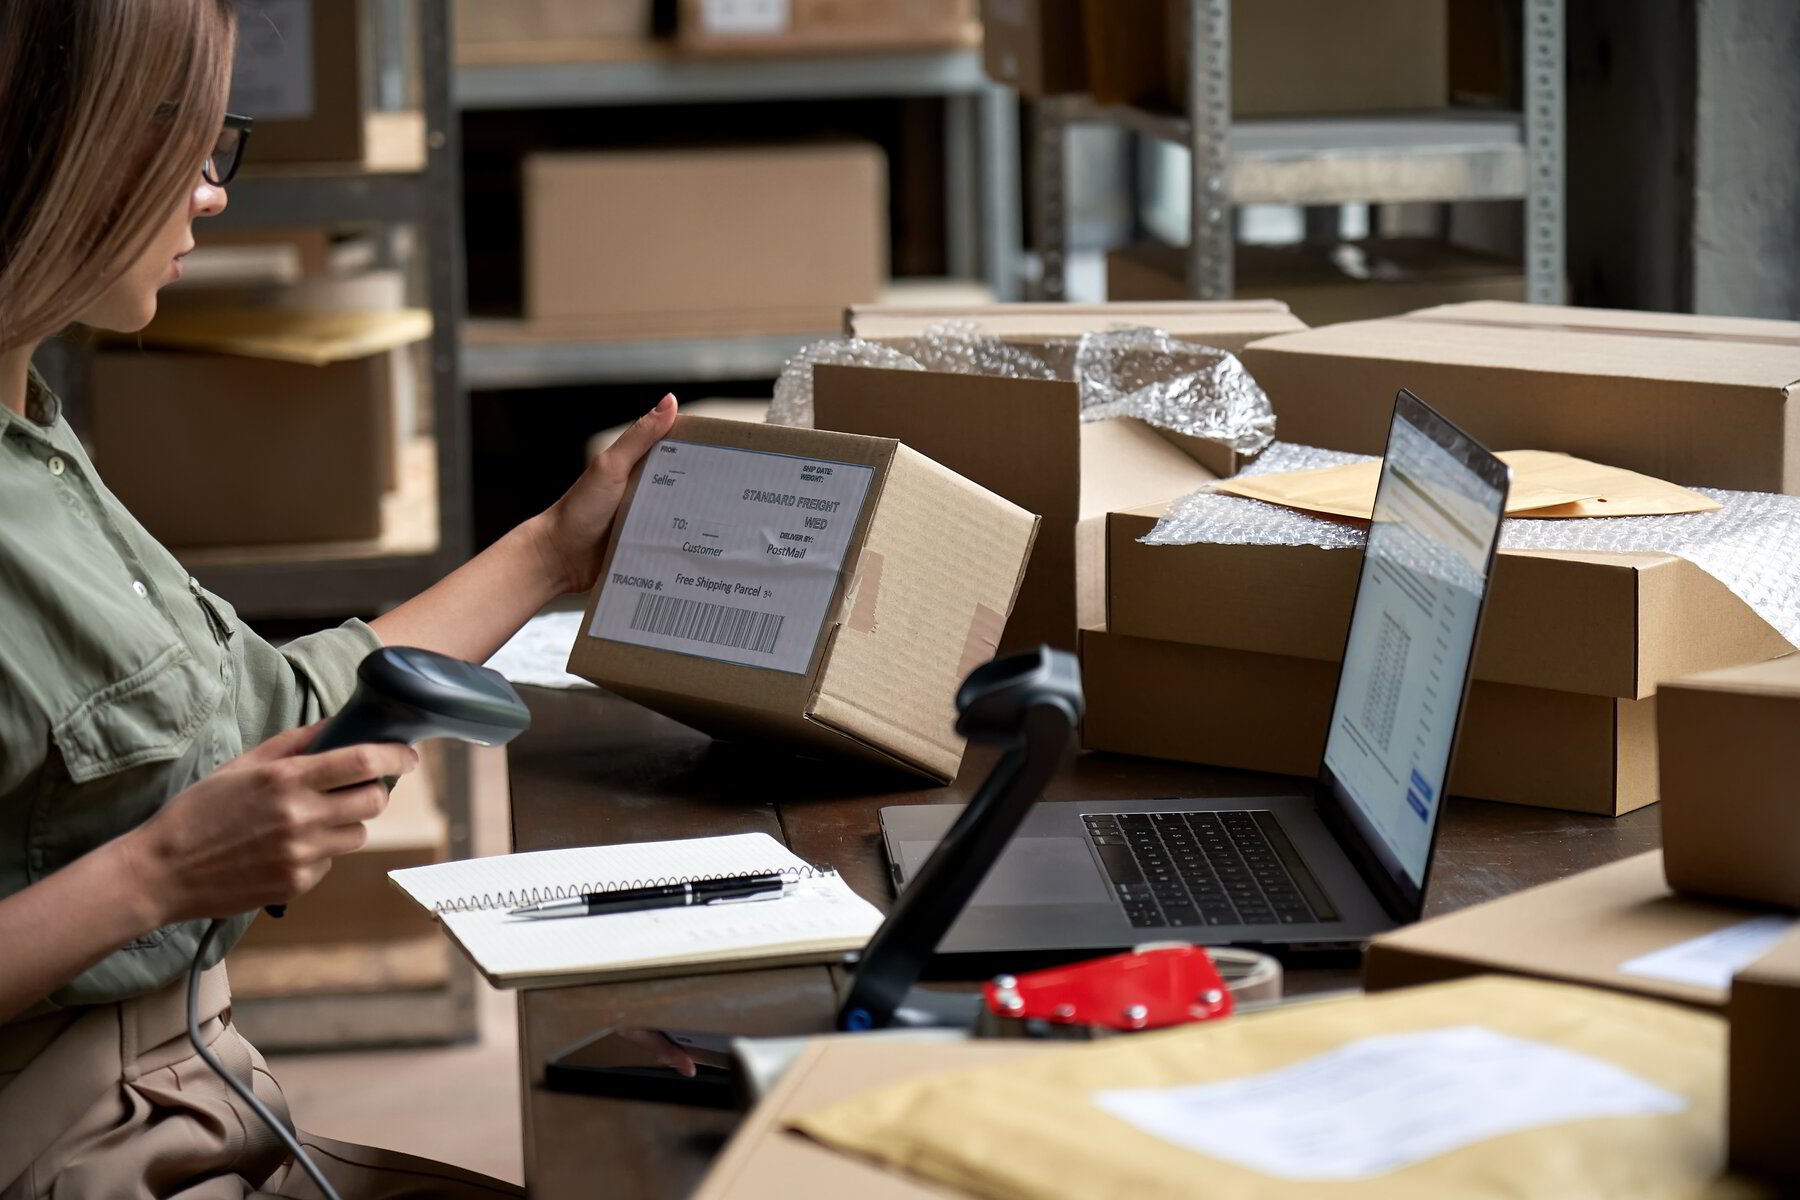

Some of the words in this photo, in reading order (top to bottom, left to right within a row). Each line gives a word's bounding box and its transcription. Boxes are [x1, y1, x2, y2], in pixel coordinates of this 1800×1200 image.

[802, 465, 816, 473] SHIP
[816, 467, 833, 475] DATE:
[651, 473, 676, 486] Seller
[800, 473, 824, 483] WEIGHT:
[742, 488, 796, 507] STANDARD
[796, 496, 840, 513] FREIGHT
[672, 517, 689, 530] TO:
[804, 516, 828, 530] WED
[779, 532, 804, 542] DELIVER
[803, 535, 814, 543] BY:
[682, 541, 724, 557] Customer
[766, 543, 807, 559] PostMail
[612, 572, 654, 590] TRACKING
[675, 573, 695, 586] Free
[695, 576, 733, 595] Shipping
[733, 582, 762, 597] Parcel
